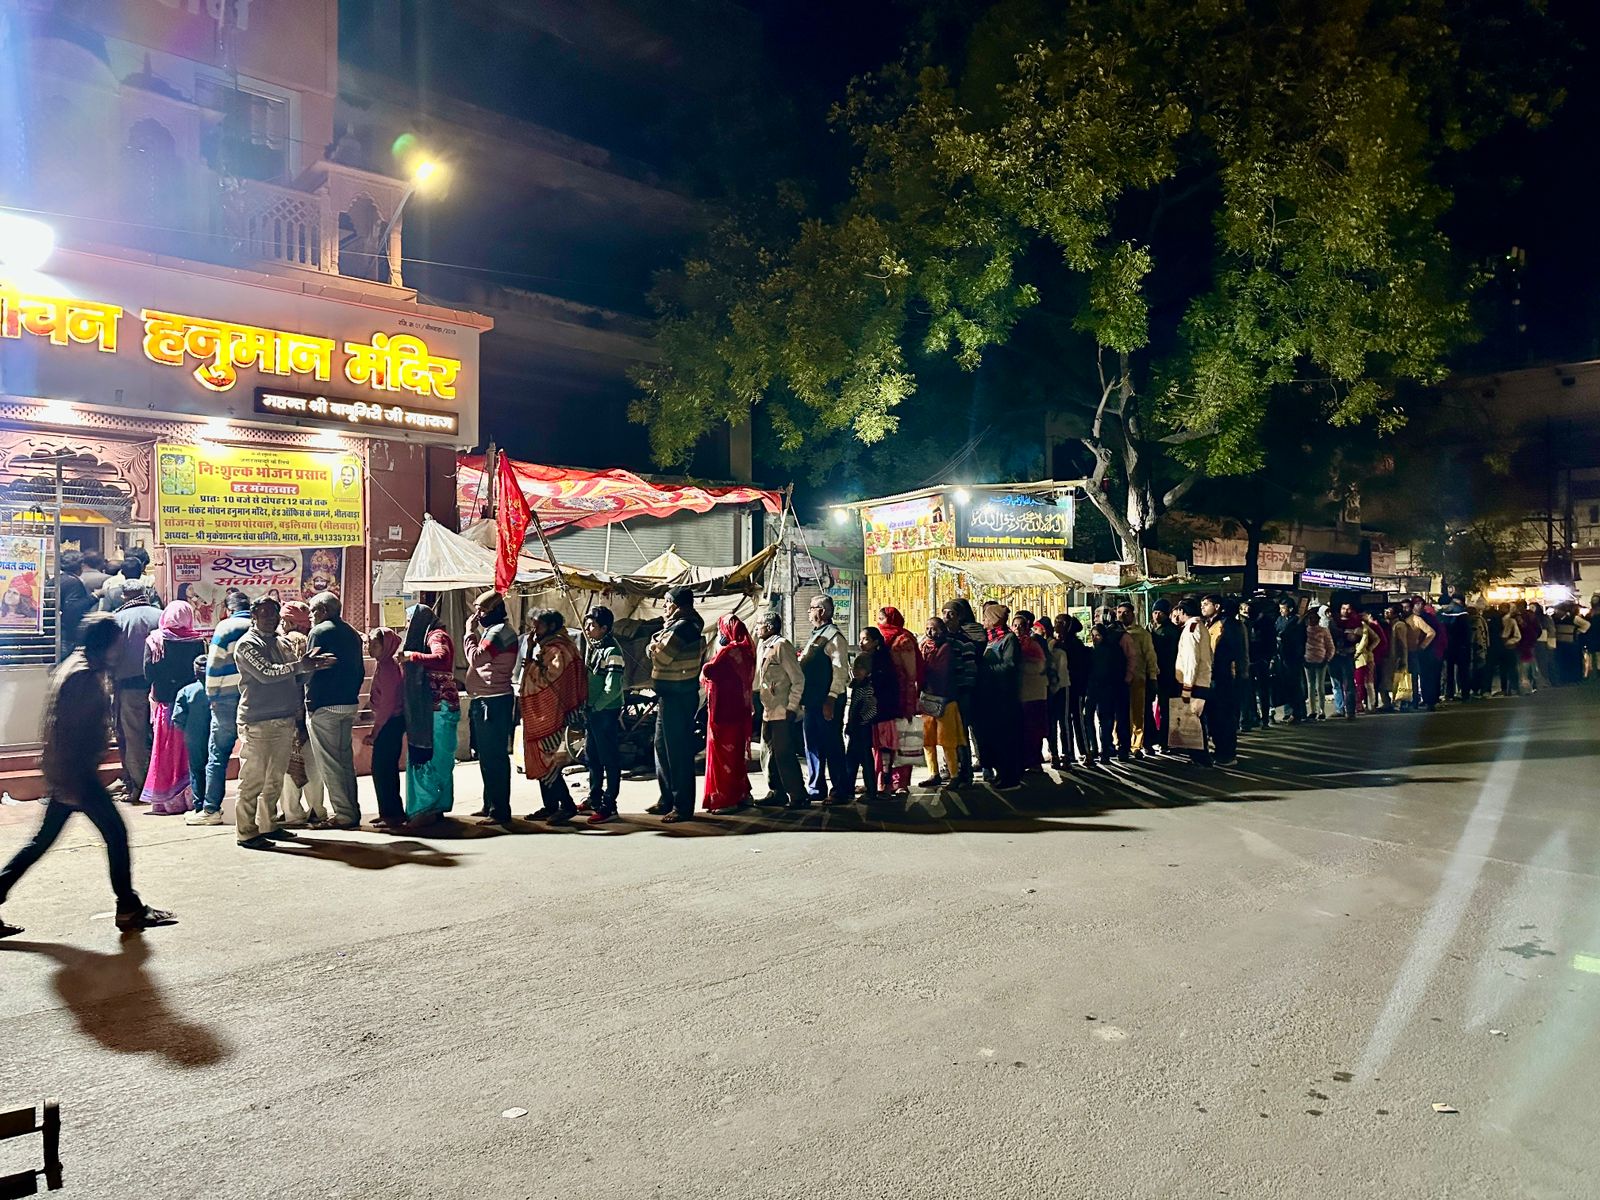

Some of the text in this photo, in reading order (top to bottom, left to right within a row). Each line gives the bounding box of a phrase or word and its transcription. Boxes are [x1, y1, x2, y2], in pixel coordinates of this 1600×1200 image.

[0, 291, 462, 400] ोचन हनुमान मंदिर
[384, 406, 403, 423] जी
[198, 461, 328, 481] निःशुल्क भोजन प्रसाद
[232, 483, 297, 494] हर मंगलवार
[236, 495, 251, 503] बजे
[252, 495, 259, 504] से
[300, 497, 313, 506] बजे
[162, 505, 180, 514] स्थान
[188, 504, 206, 514] संकट
[227, 507, 250, 517] हनुमान
[197, 517, 205, 527] से
[214, 519, 241, 528] प्रकाश
[195, 530, 205, 540] श्री
[314, 534, 360, 542] 9413357331
[18, 562, 37, 571] कथा
[211, 555, 296, 577] श्याम
[214, 574, 296, 586] संकीर्तन
